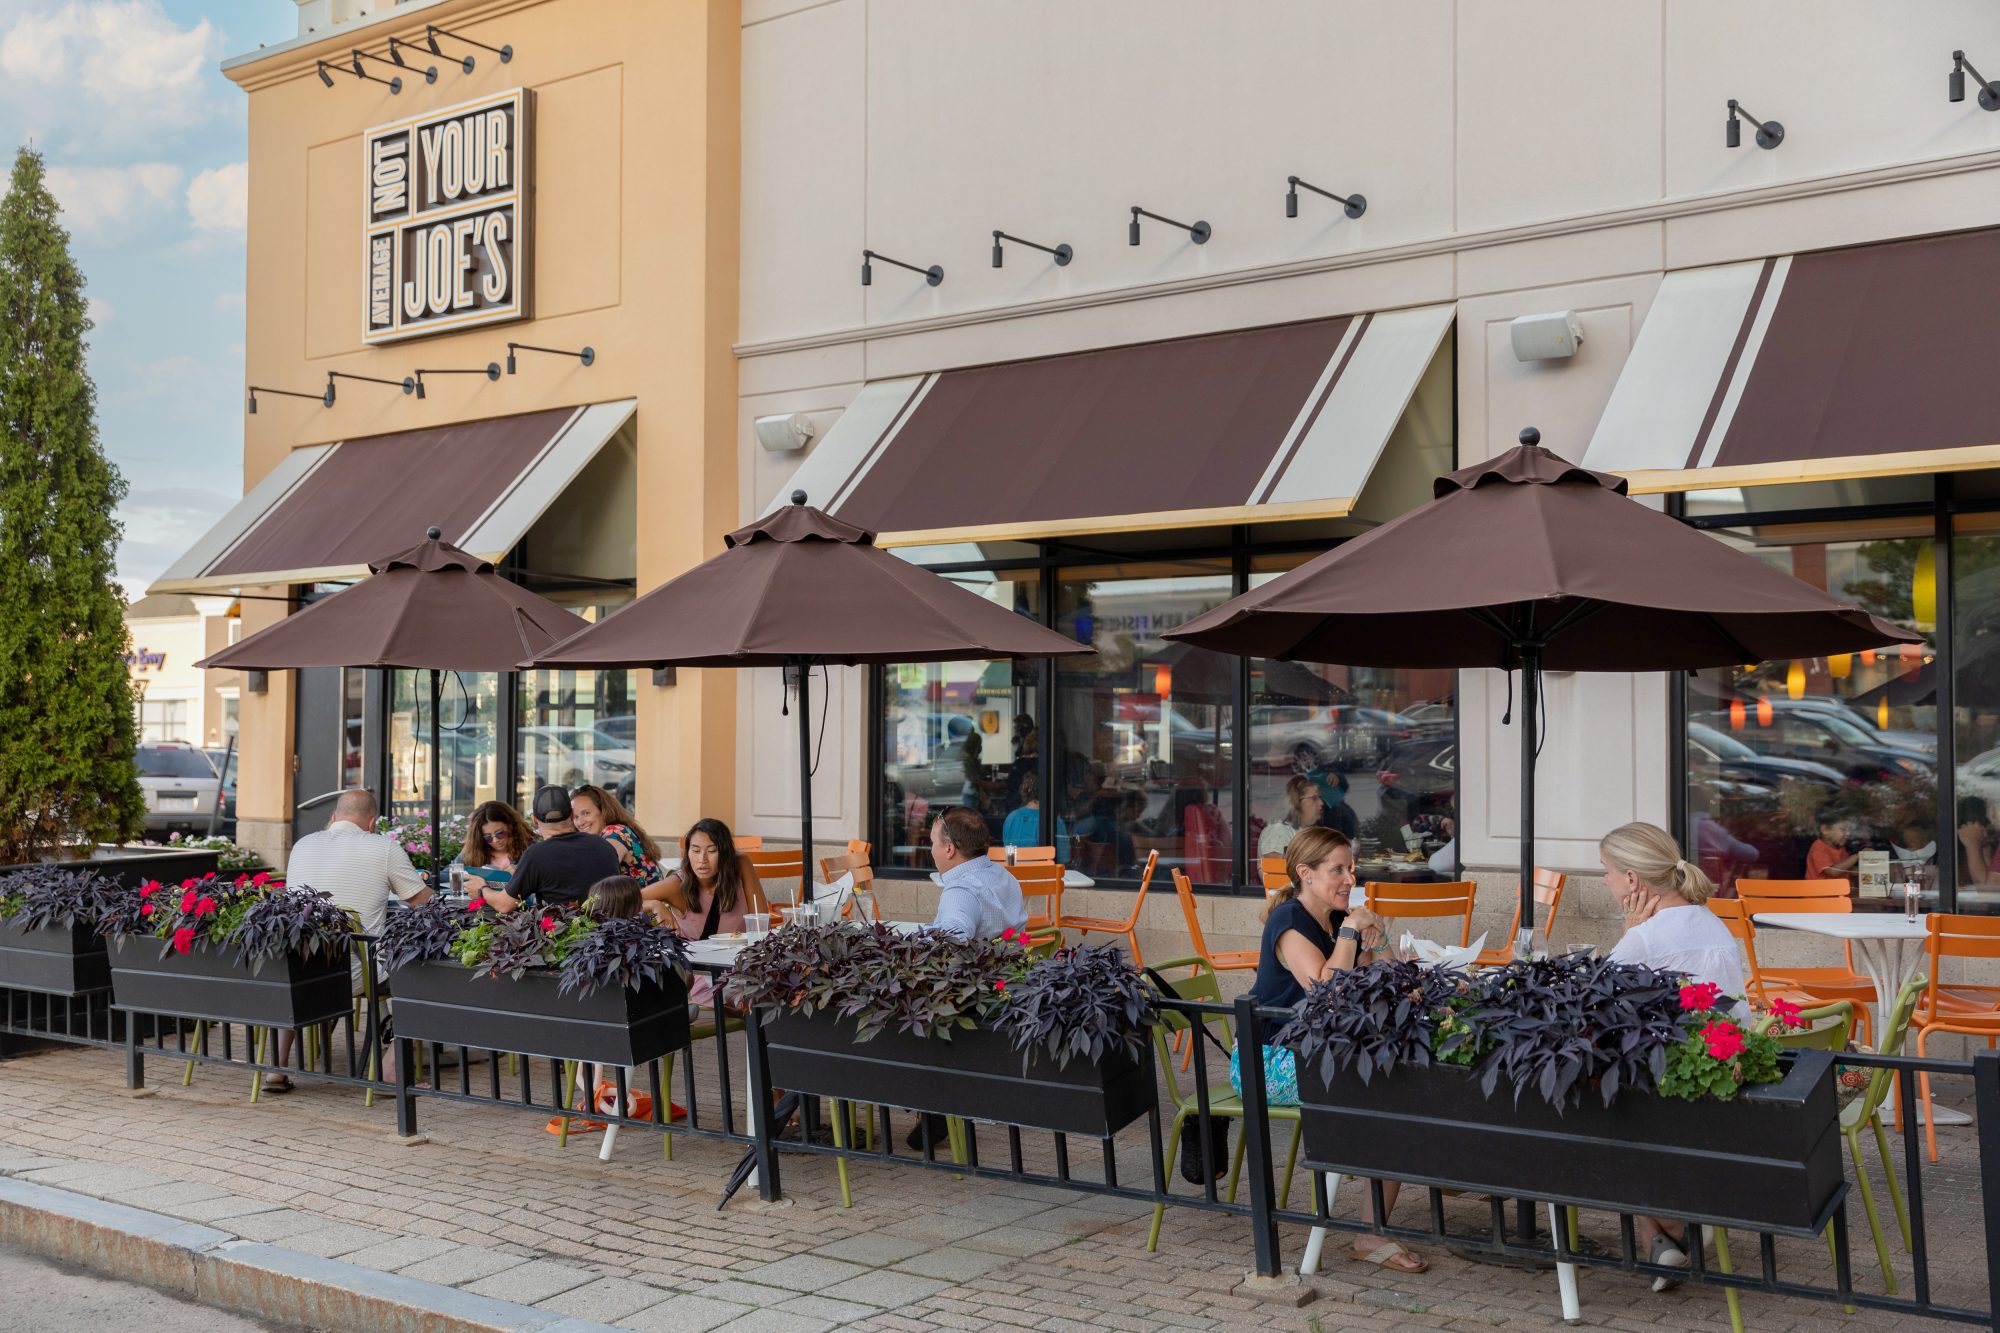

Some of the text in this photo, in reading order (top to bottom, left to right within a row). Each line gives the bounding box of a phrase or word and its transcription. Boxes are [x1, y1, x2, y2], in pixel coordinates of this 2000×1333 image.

[373, 141, 406, 214] NOT
[421, 109, 508, 204] YOUR
[371, 236, 391, 324] AVERAGE
[404, 211, 508, 318] JOE'S
